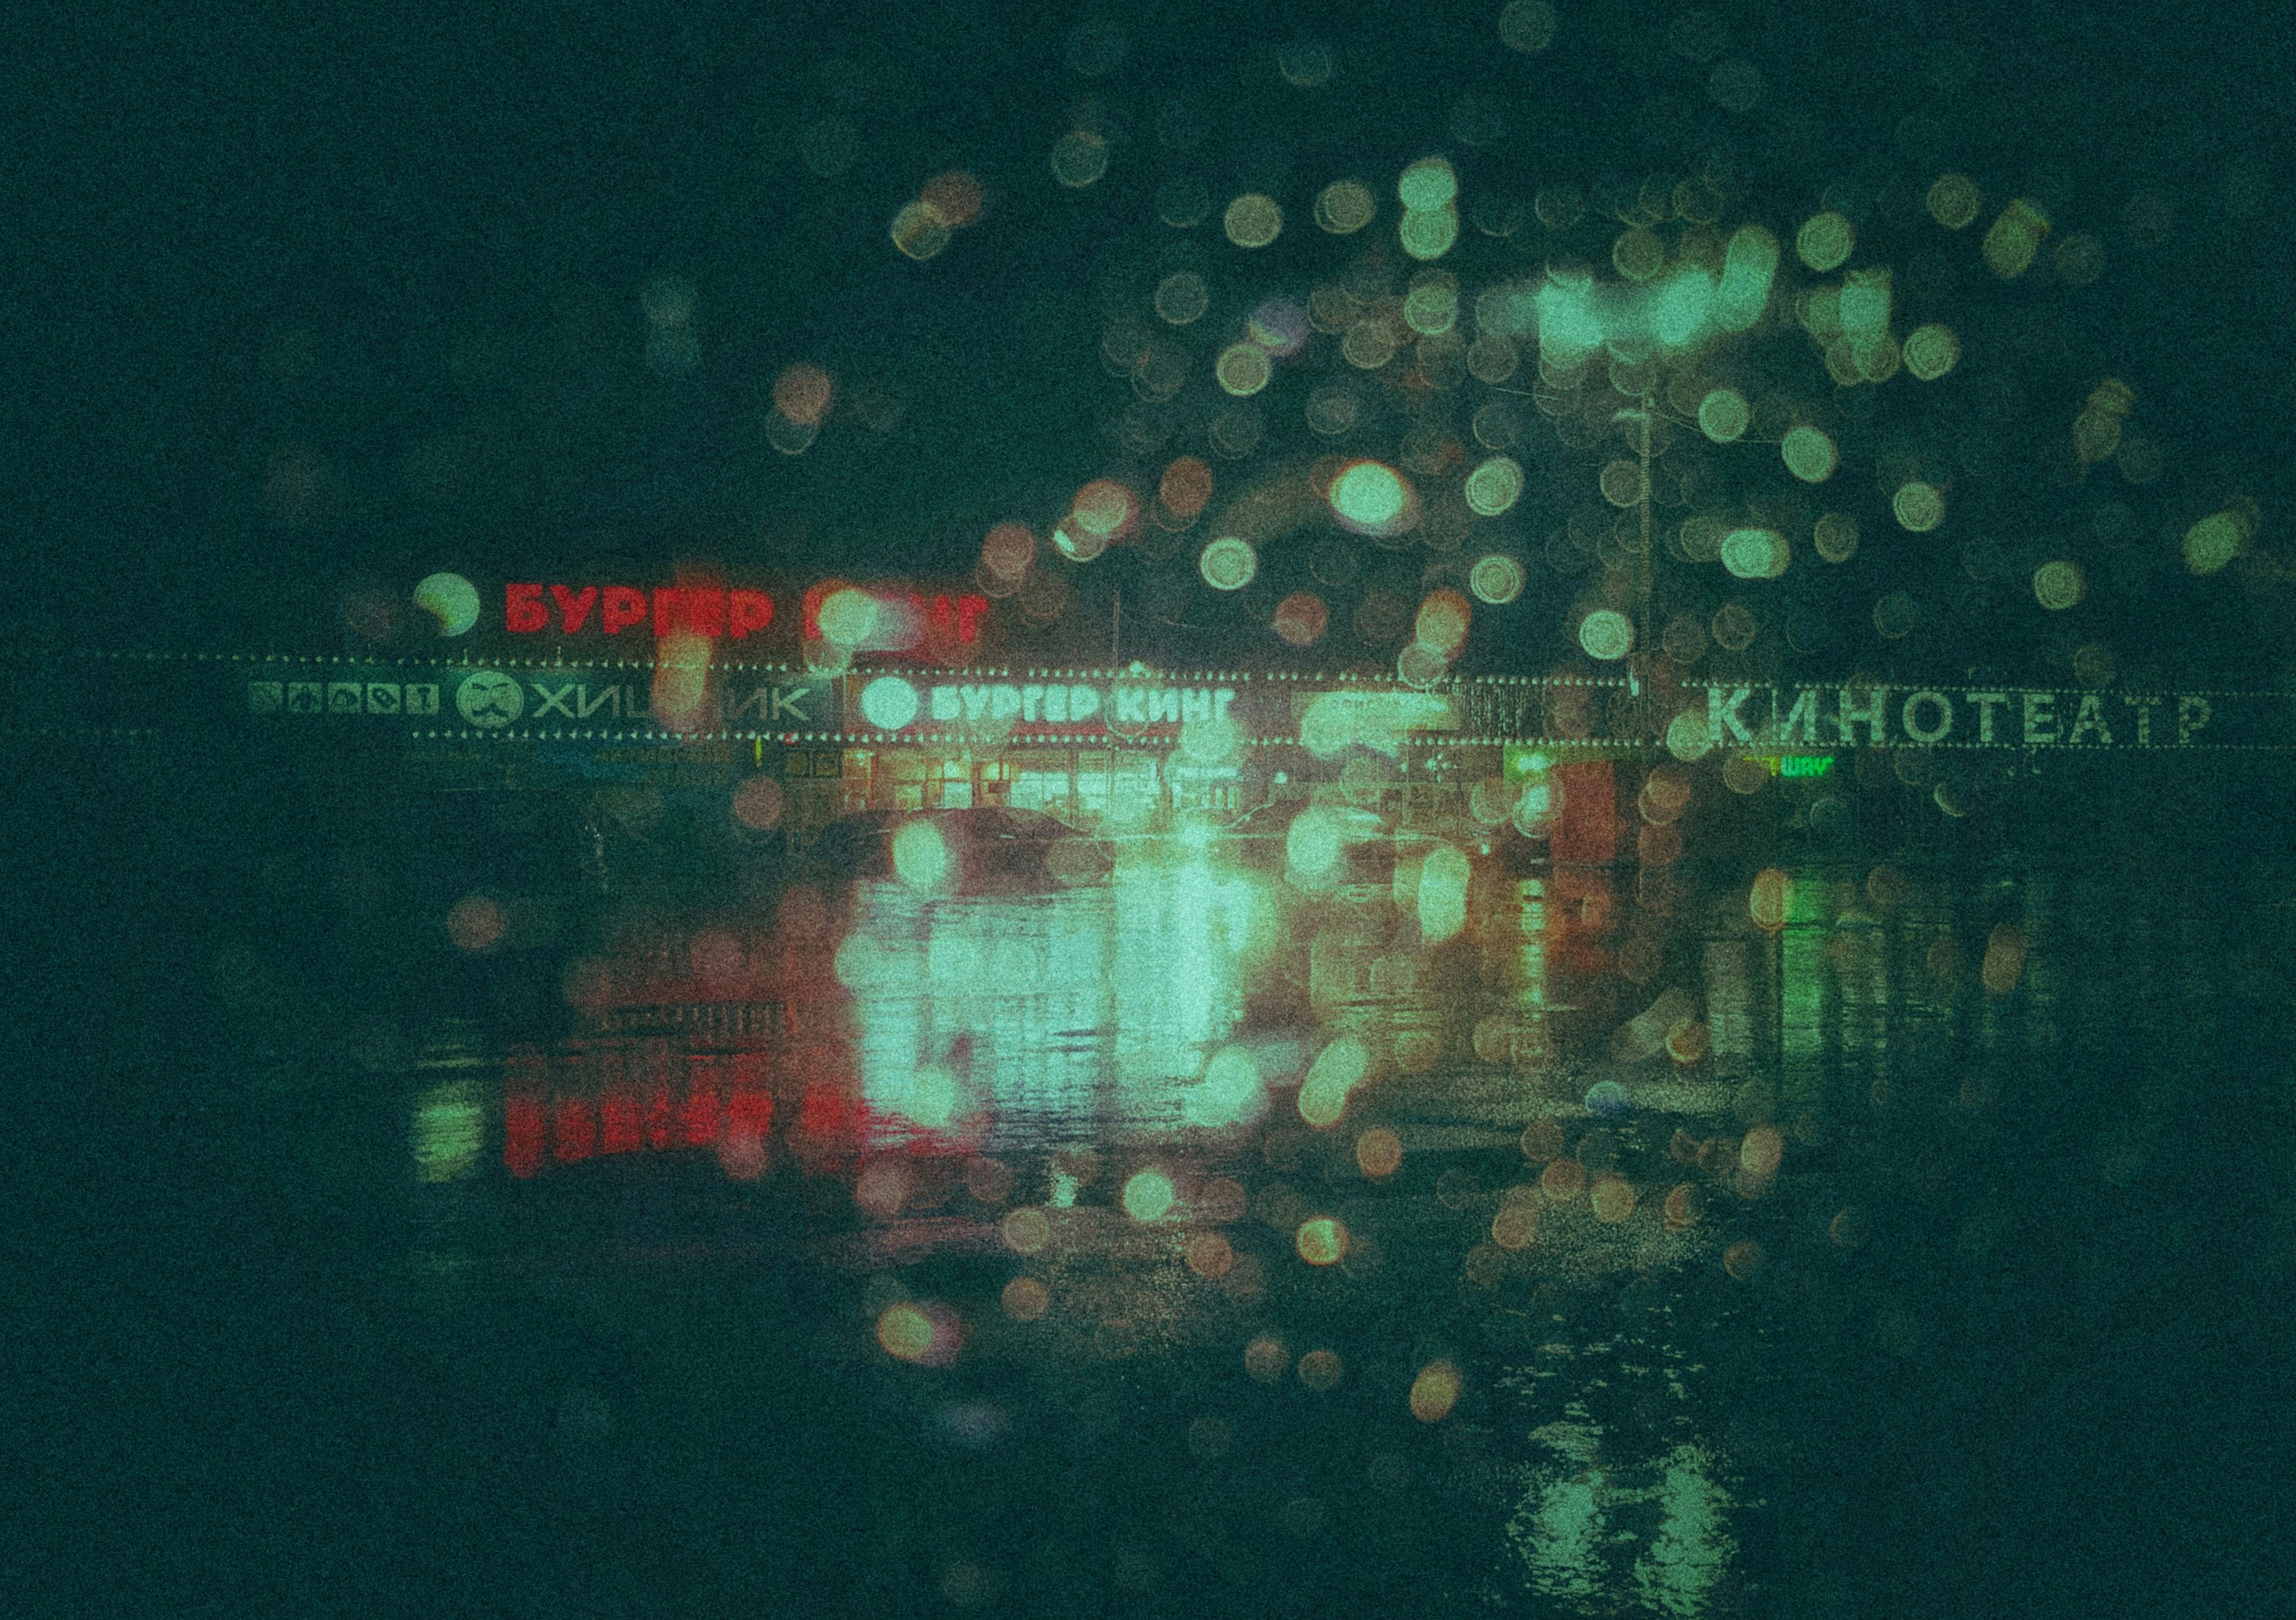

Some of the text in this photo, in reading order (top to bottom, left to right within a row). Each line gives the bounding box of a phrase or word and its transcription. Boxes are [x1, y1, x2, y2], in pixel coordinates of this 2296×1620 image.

[505, 583, 774, 639] БУРГЕР
[531, 683, 811, 721] ХИИК
[931, 684, 1235, 723] БУРГЕР КИНГ
[1708, 688, 2212, 744] КИНОТЕАТР
